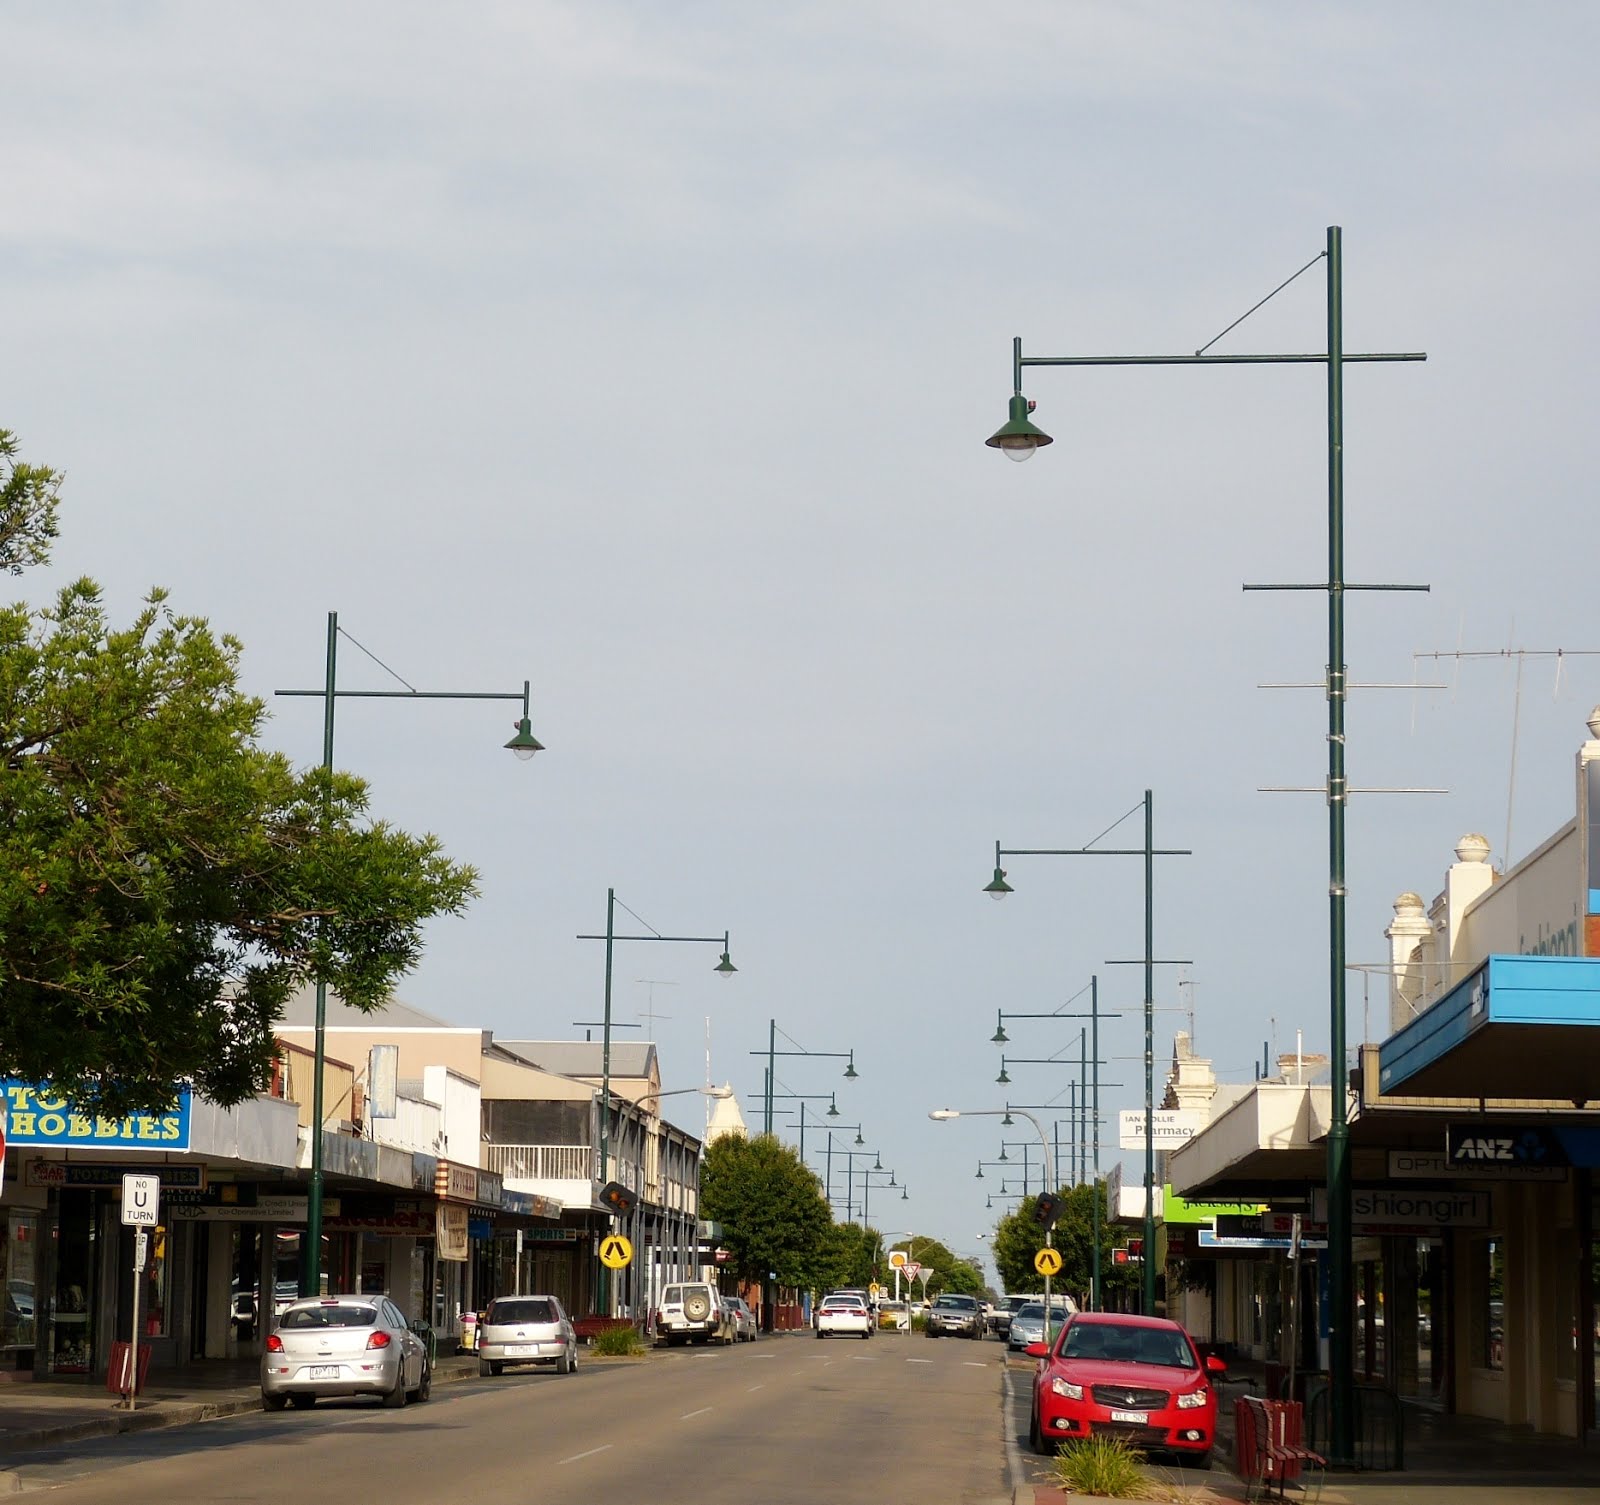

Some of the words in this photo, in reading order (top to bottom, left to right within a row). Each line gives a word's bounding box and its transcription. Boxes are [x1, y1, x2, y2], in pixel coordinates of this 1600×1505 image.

[10, 1113, 180, 1140] HOBBIES
[1135, 1125, 1195, 1136] Parmacy
[1455, 1138, 1514, 1160] ANZ
[135, 1192, 147, 1207] U
[127, 1210, 154, 1220] TURN
[1353, 1193, 1475, 1223] shiongirl
[527, 1229, 565, 1240] SPORTS
